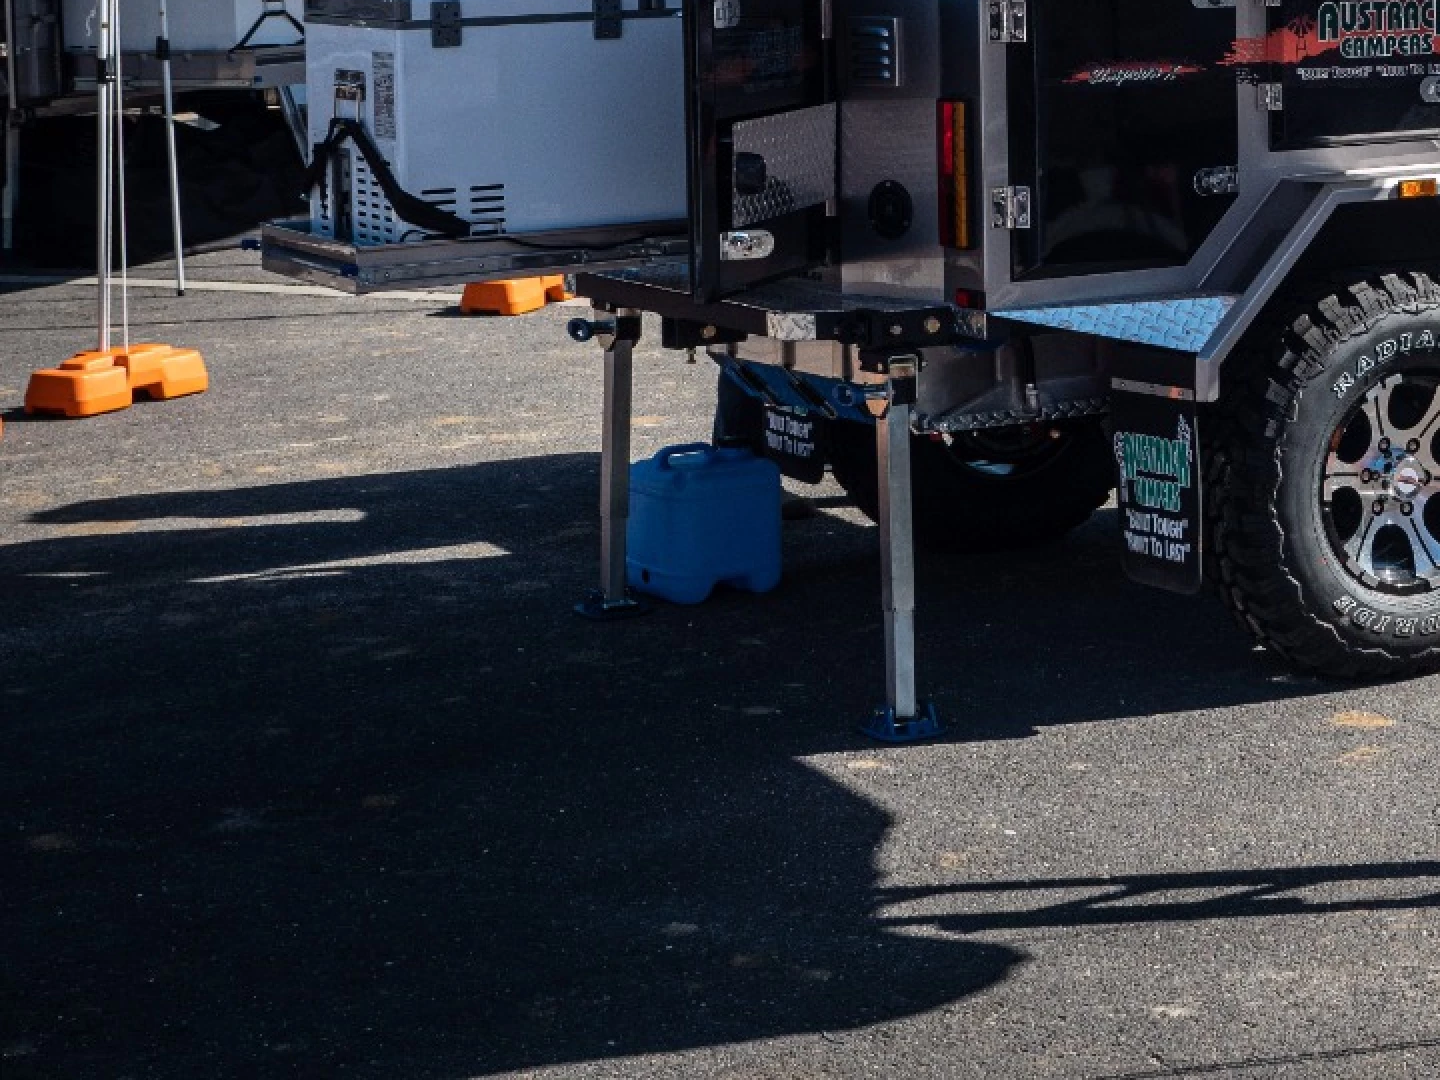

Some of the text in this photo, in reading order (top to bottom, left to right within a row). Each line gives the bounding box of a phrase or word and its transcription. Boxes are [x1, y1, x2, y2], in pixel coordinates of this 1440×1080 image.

[1339, 33, 1434, 58] CAMPERS
[1122, 431, 1191, 488] AUSTRACK
[1135, 477, 1181, 512] CAMPERS
